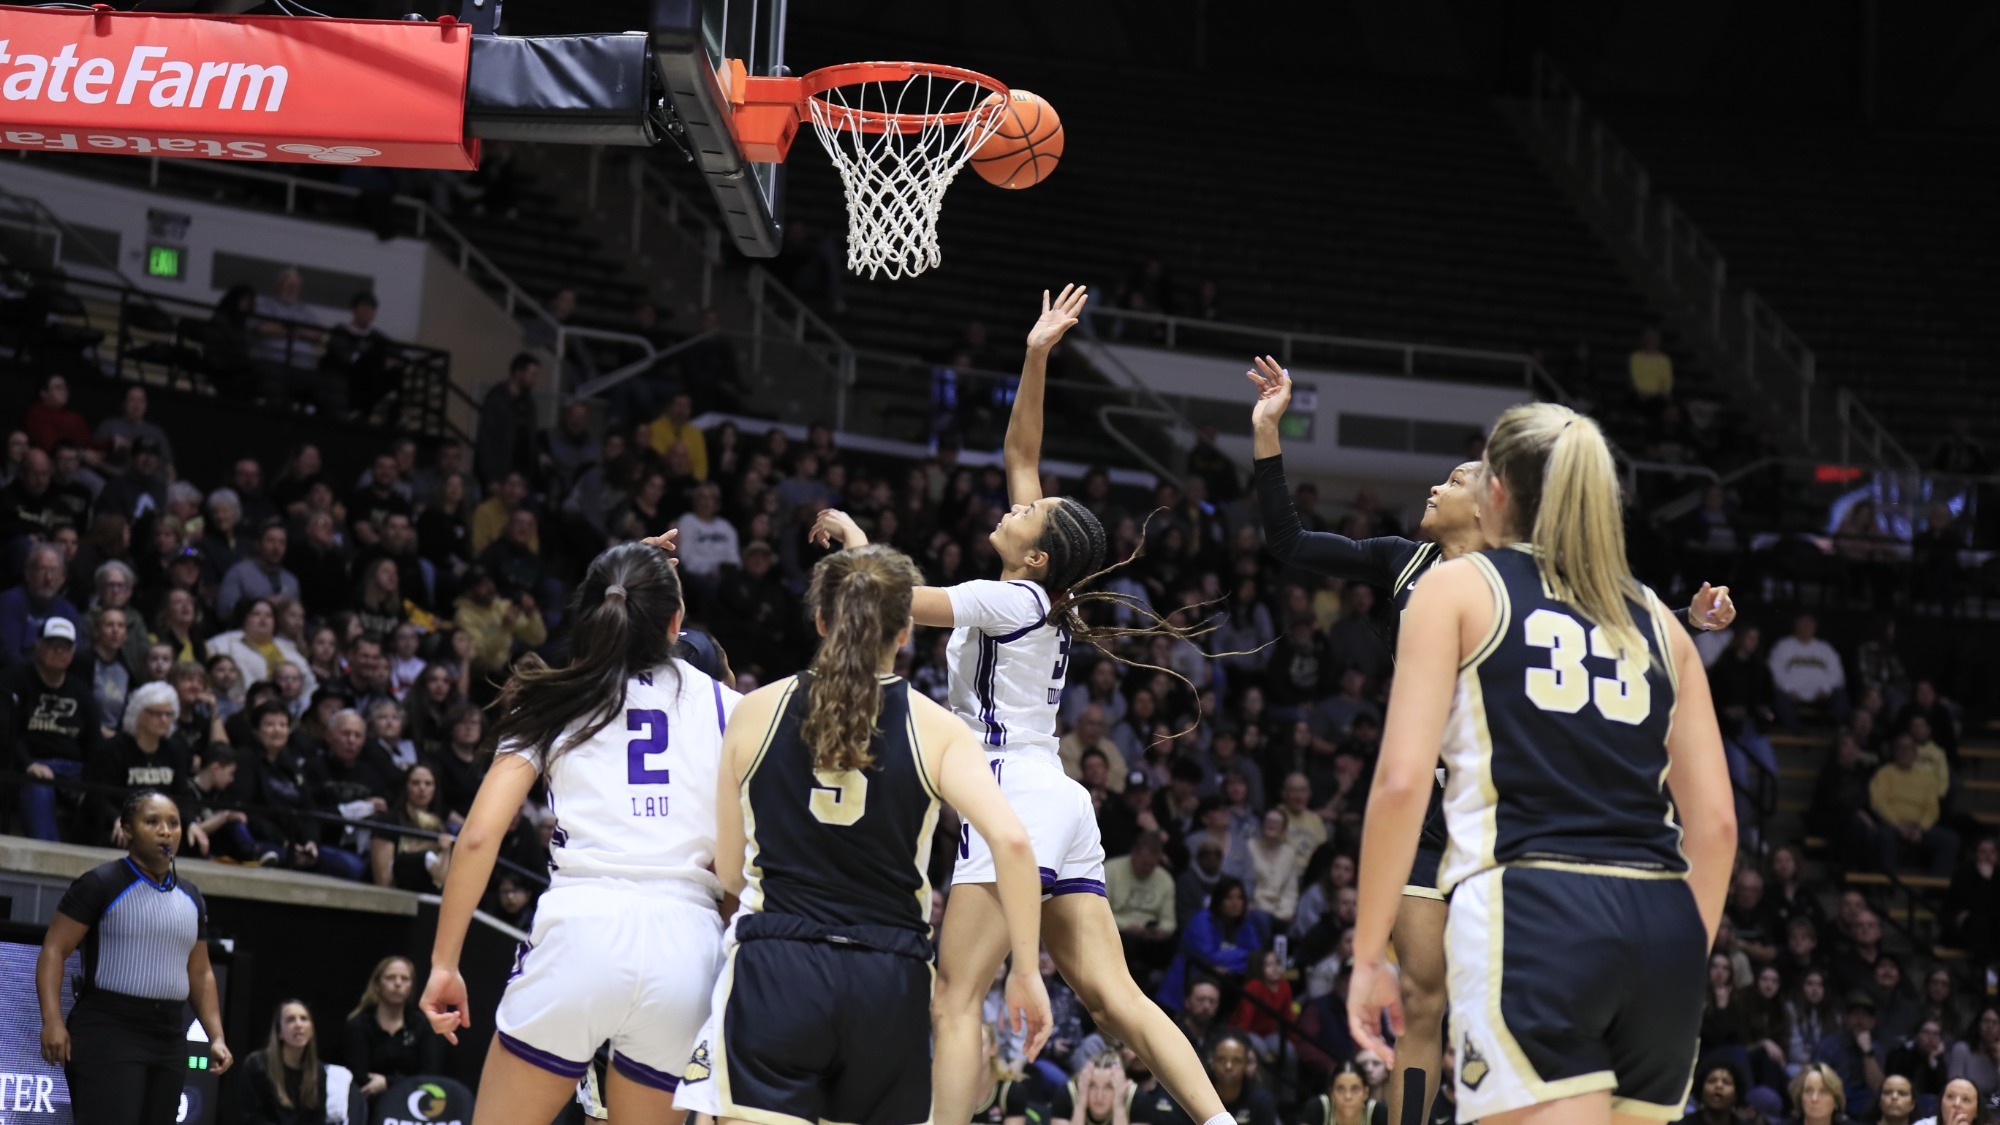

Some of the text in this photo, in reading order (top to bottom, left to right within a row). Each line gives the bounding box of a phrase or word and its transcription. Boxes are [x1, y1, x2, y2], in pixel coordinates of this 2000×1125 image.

[0, 130, 268, 159] State Fa
[1523, 608, 1651, 726] 33
[626, 708, 670, 785] 2
[631, 796, 669, 817] LAU
[0, 1072, 57, 1114] TER
